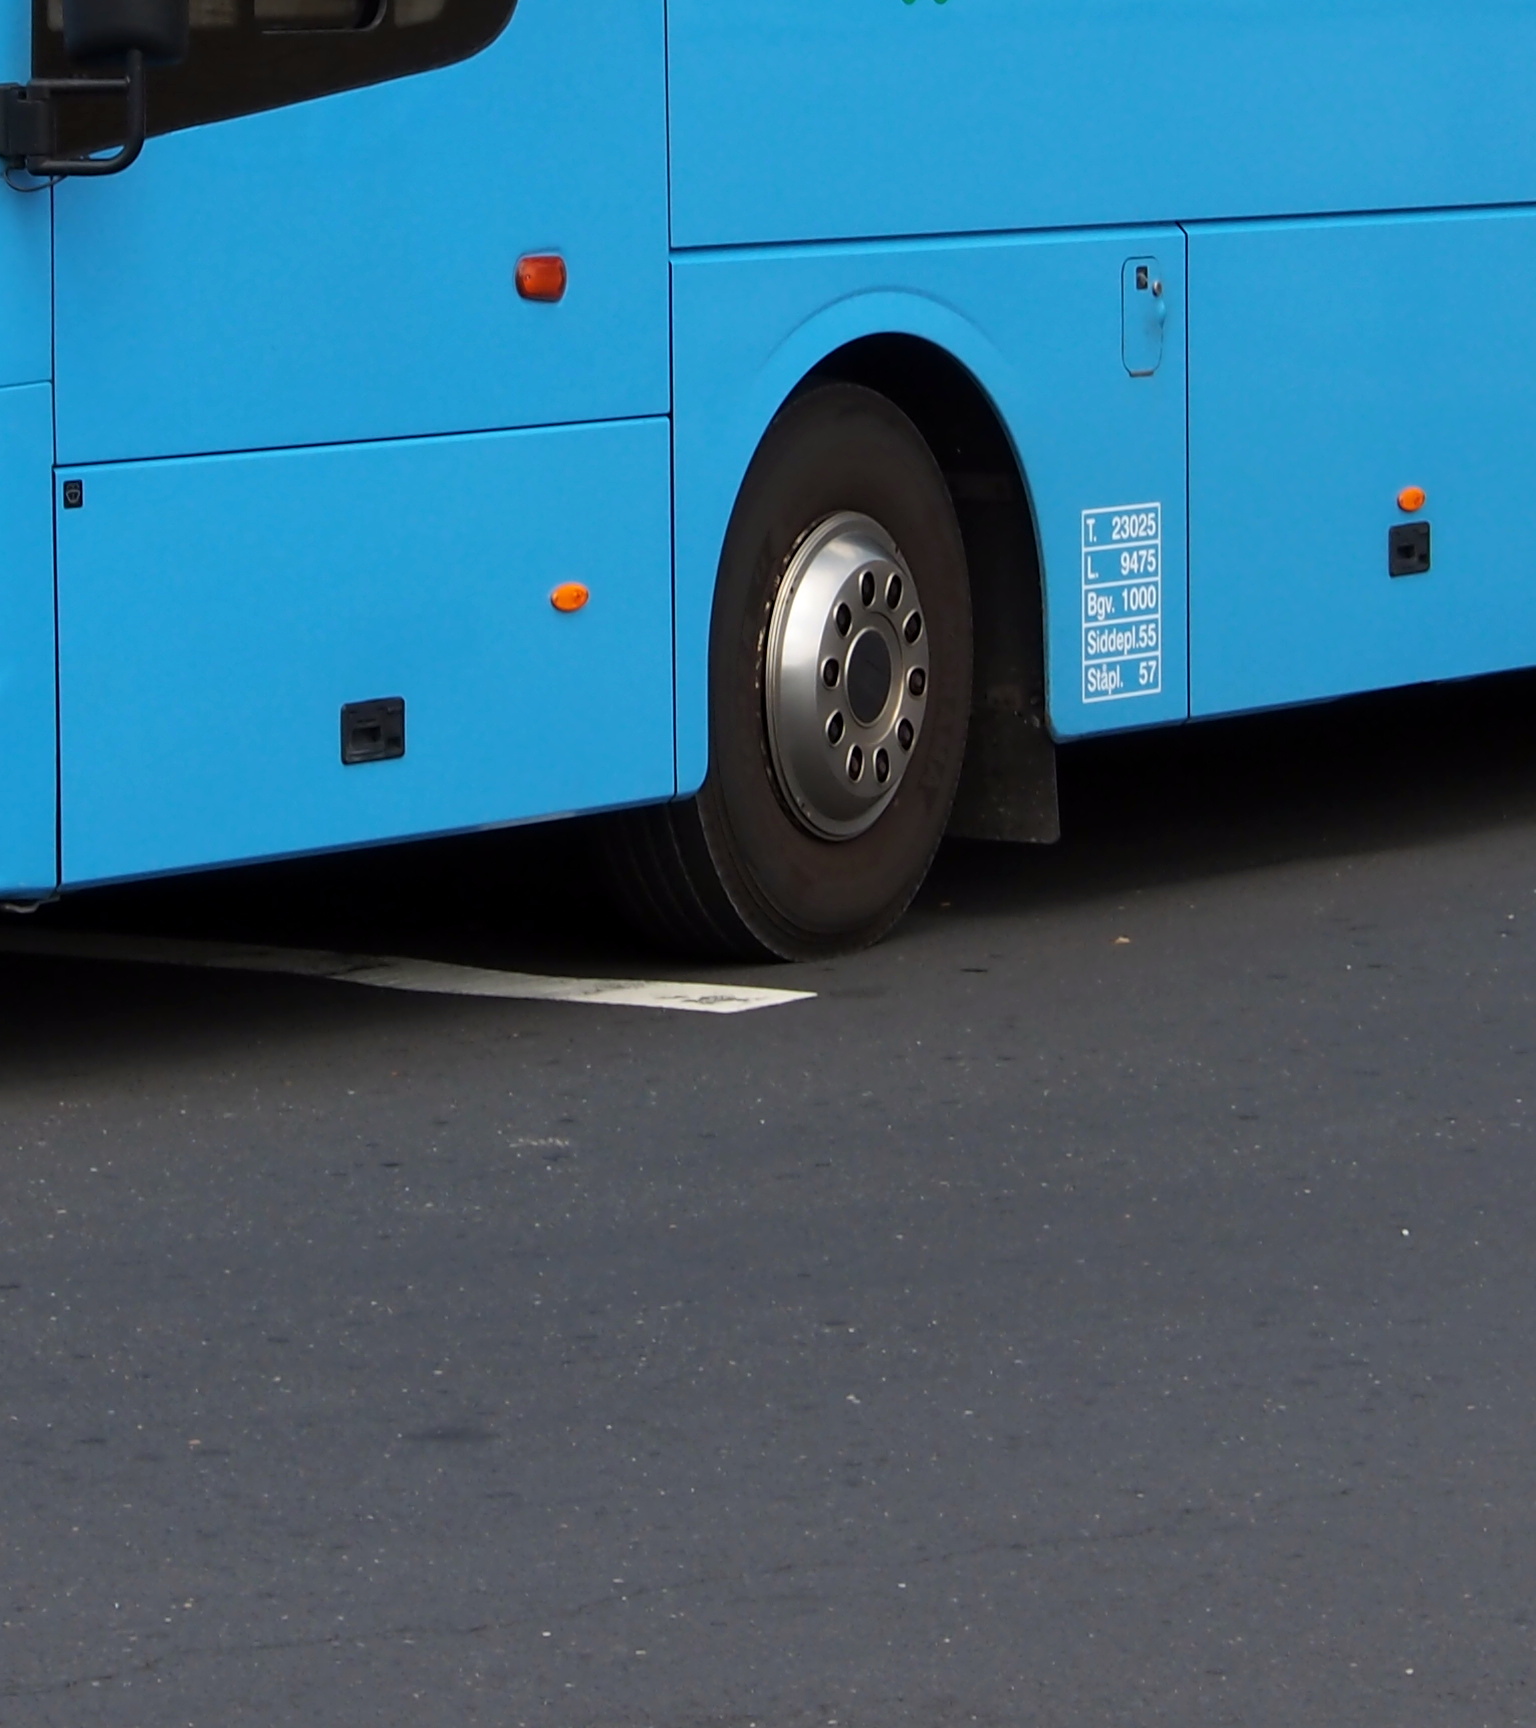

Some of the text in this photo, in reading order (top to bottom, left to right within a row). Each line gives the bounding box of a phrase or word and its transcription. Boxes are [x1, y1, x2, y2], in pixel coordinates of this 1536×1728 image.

[1086, 513, 1156, 542] T. 23025
[1087, 549, 1156, 579] L. 9475
[1087, 585, 1156, 620] Bgv. 1000
[1087, 624, 1156, 655] Siddepl. 55
[1087, 660, 1157, 694] Ståpl. 57
